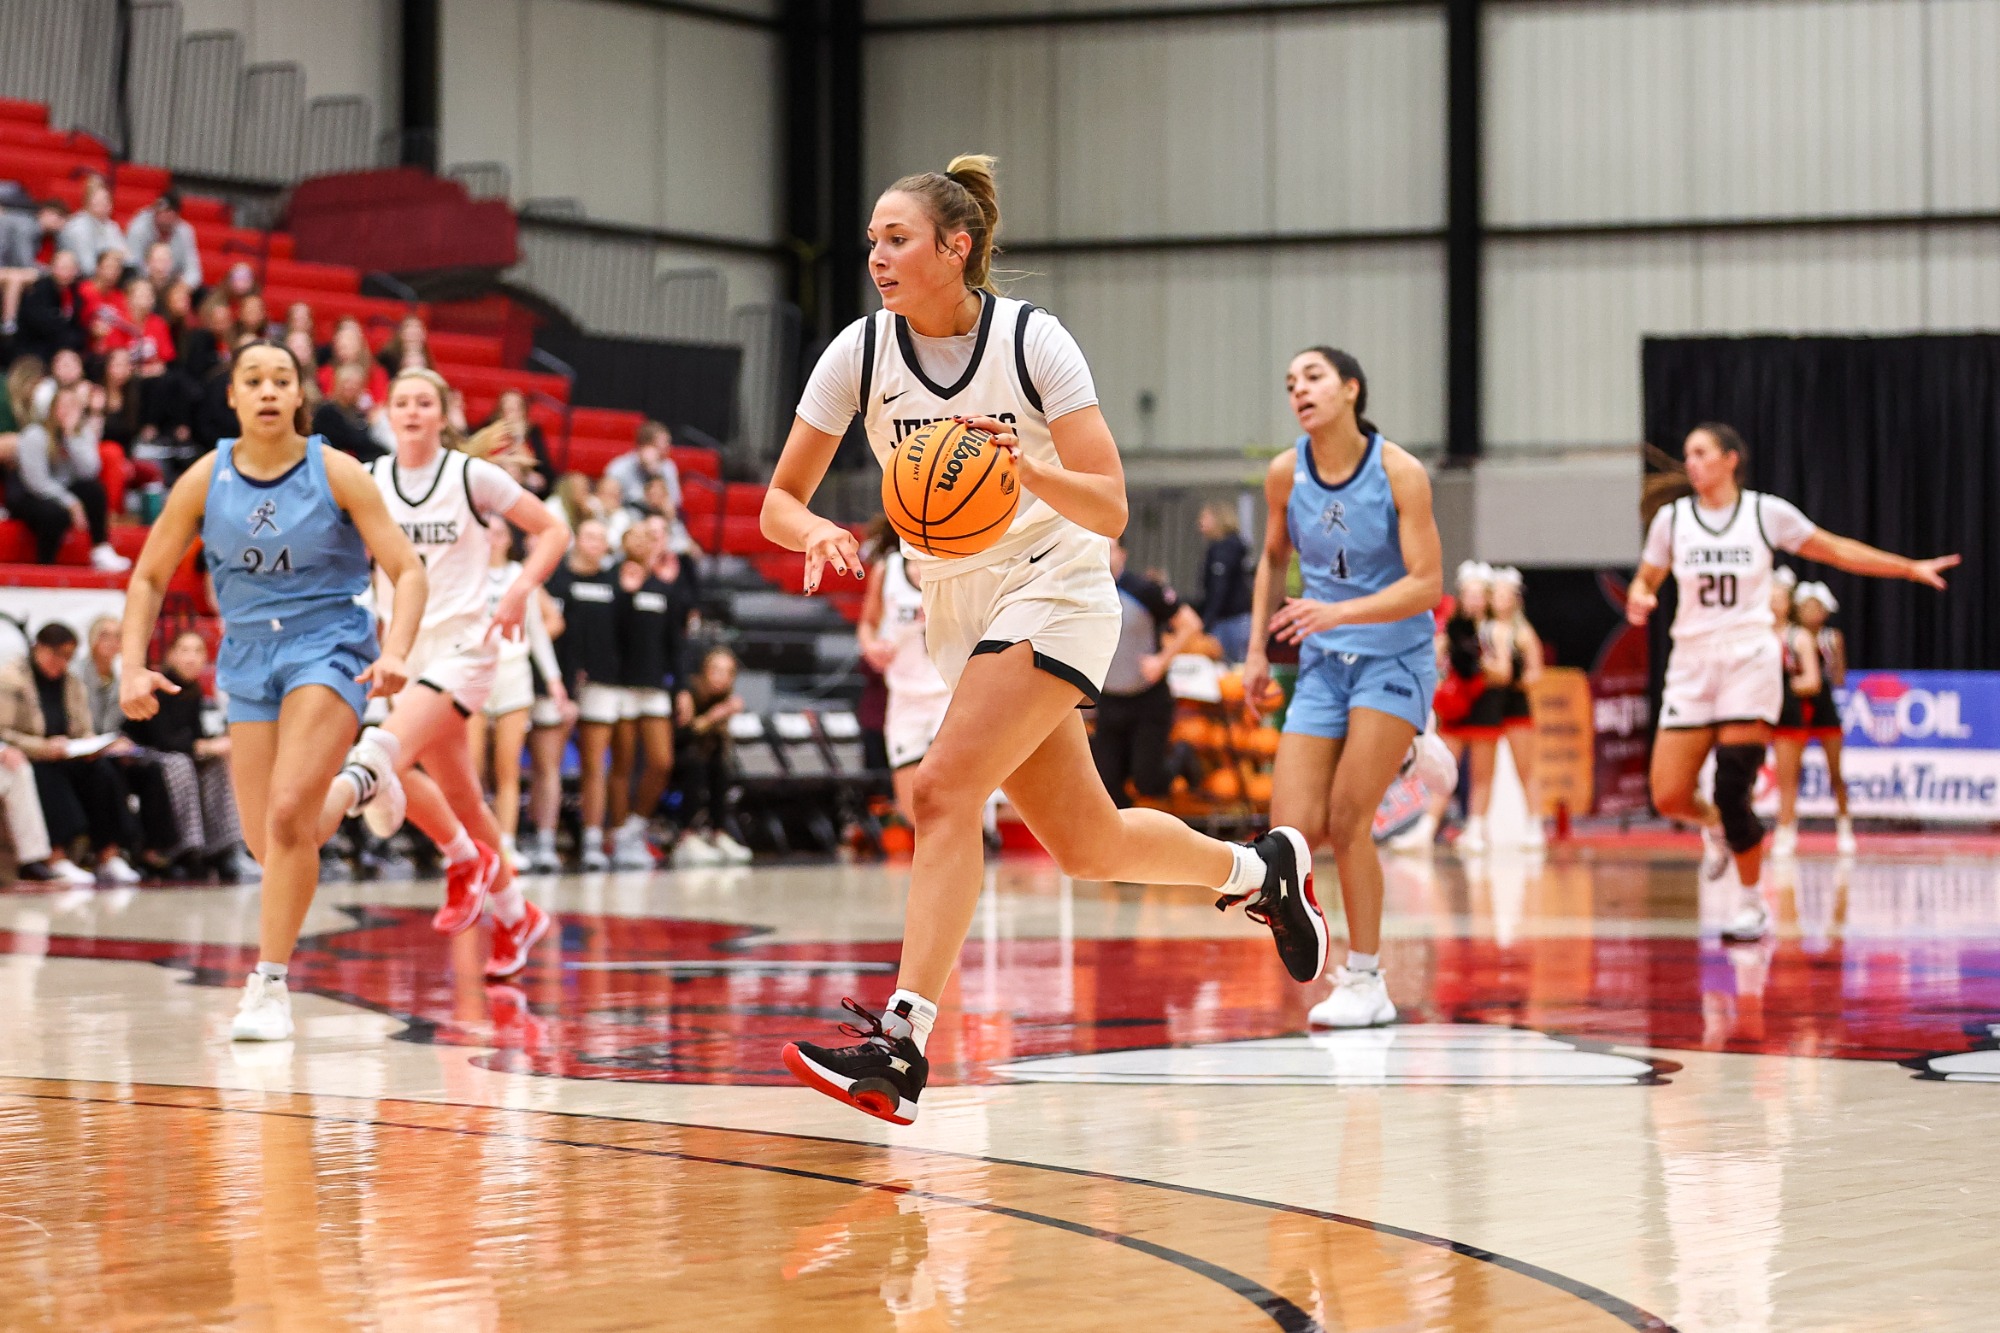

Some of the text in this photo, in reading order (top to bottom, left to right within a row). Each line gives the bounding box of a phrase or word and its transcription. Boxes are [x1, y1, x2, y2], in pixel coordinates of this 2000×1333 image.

[937, 424, 992, 492] Wilson
[1698, 572, 1736, 608] 20
[1798, 756, 1996, 802] BeakTime
